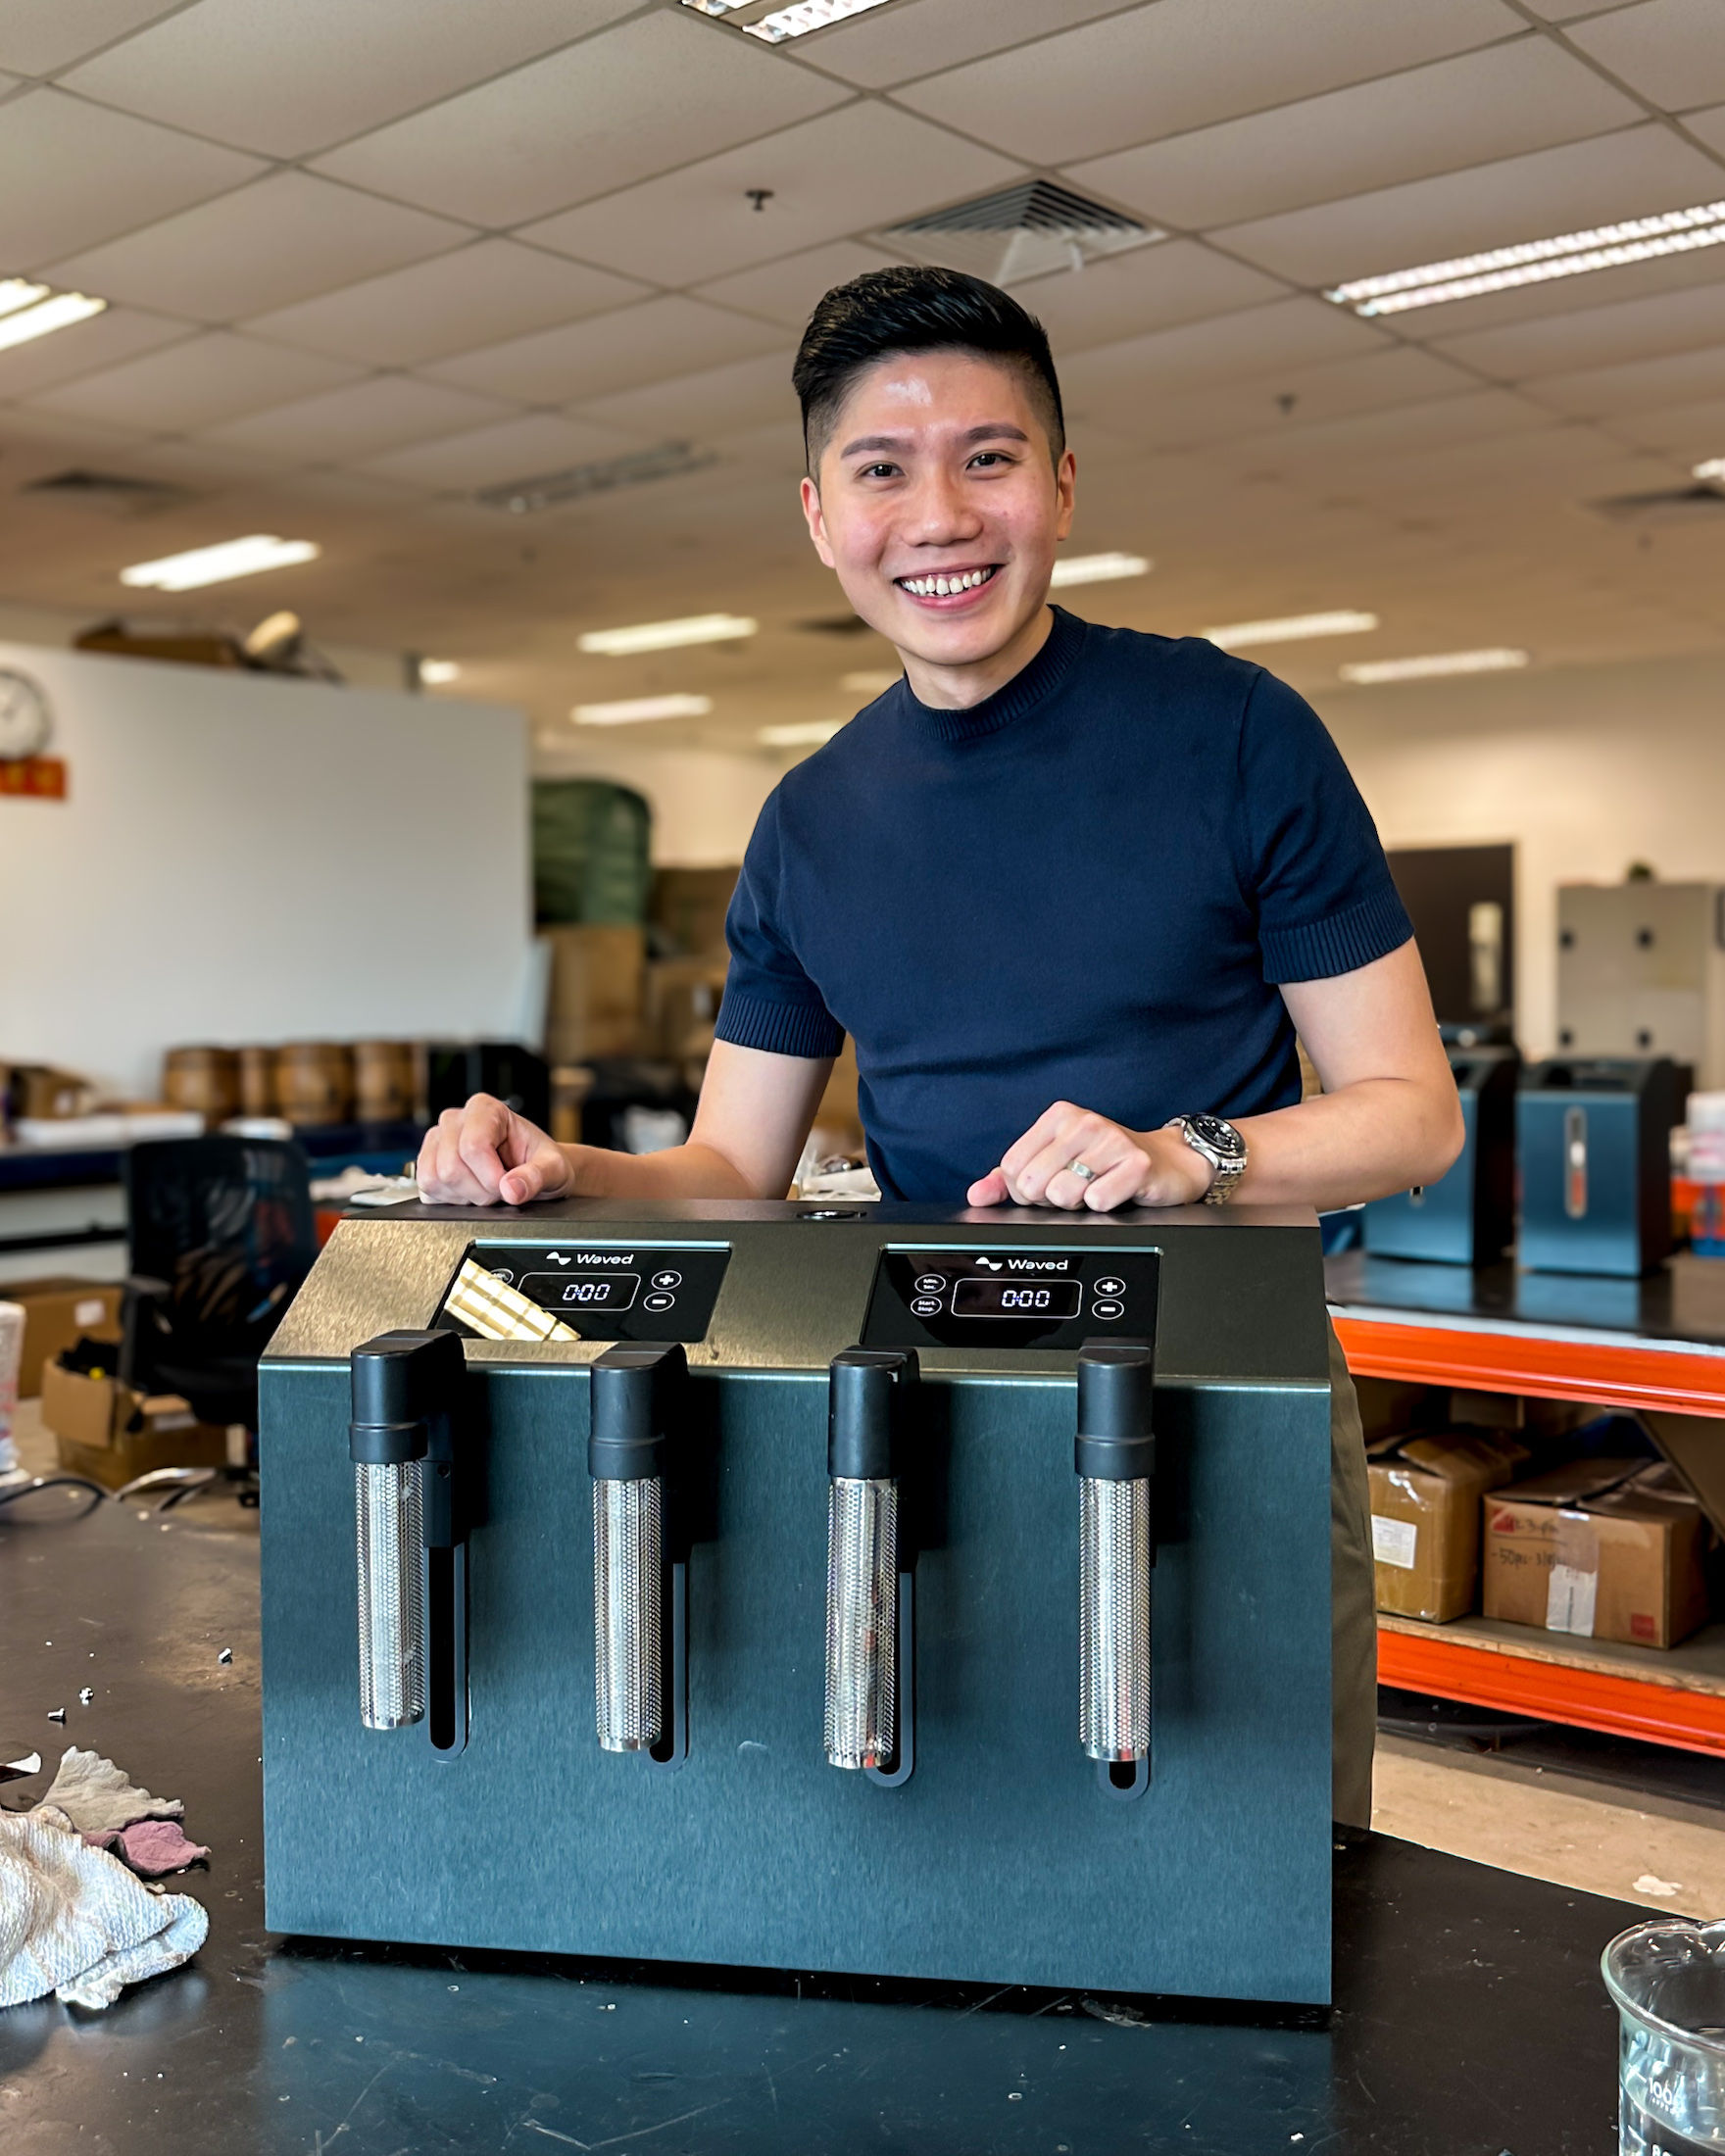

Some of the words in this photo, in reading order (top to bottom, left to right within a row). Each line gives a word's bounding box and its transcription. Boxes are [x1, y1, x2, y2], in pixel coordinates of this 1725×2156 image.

[576, 1253, 634, 1265] Waved
[1008, 1259, 1068, 1270] Waved
[1649, 2077, 1673, 2105] 100
